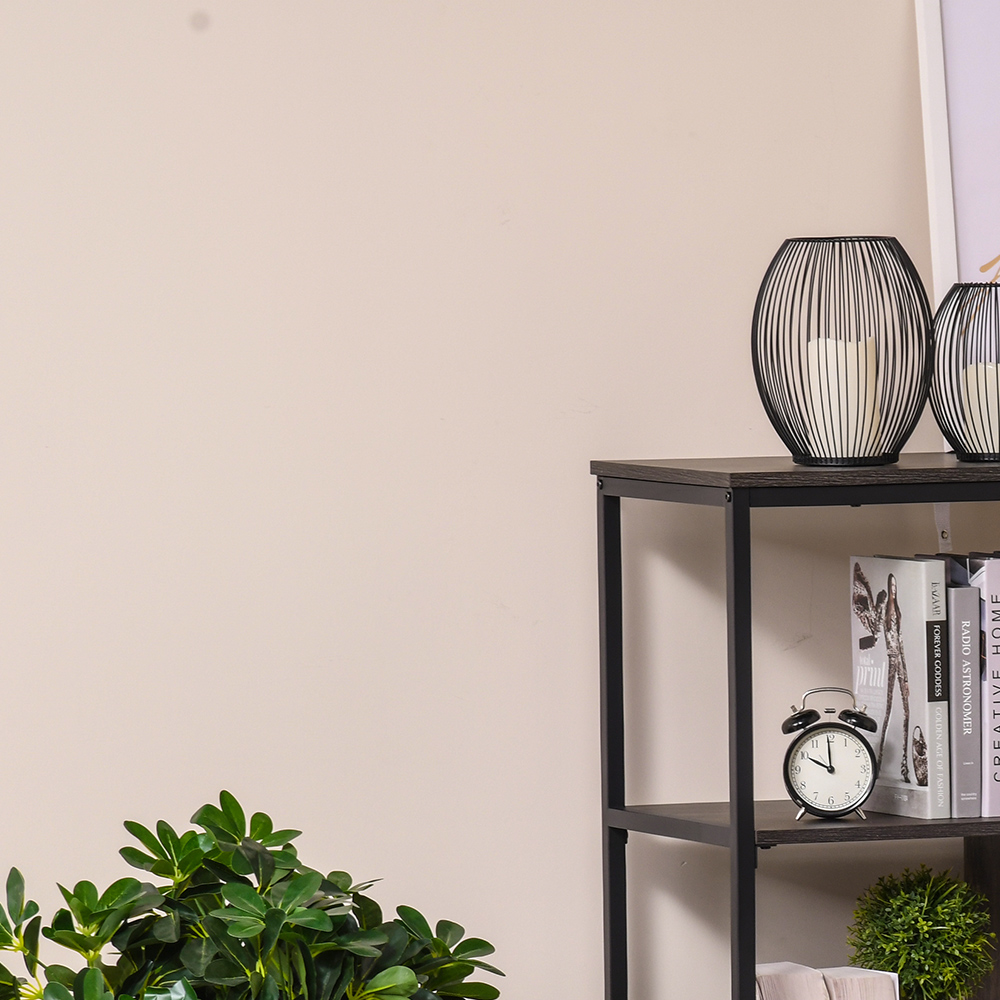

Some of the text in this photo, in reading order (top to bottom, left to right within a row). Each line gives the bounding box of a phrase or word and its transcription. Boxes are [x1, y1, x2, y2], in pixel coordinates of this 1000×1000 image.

[933, 624, 943, 697] FOREVER GODDESS
[961, 620, 973, 735] RADIO ASTRONOMER
[854, 748, 861, 758] 2
[935, 706, 945, 808] GOLDEN AGE OF FASHION
[860, 765, 867, 774] 3
[854, 780, 861, 789] 4
[812, 791, 819, 801] 7
[827, 795, 835, 805] 6
[844, 792, 851, 801] 5
